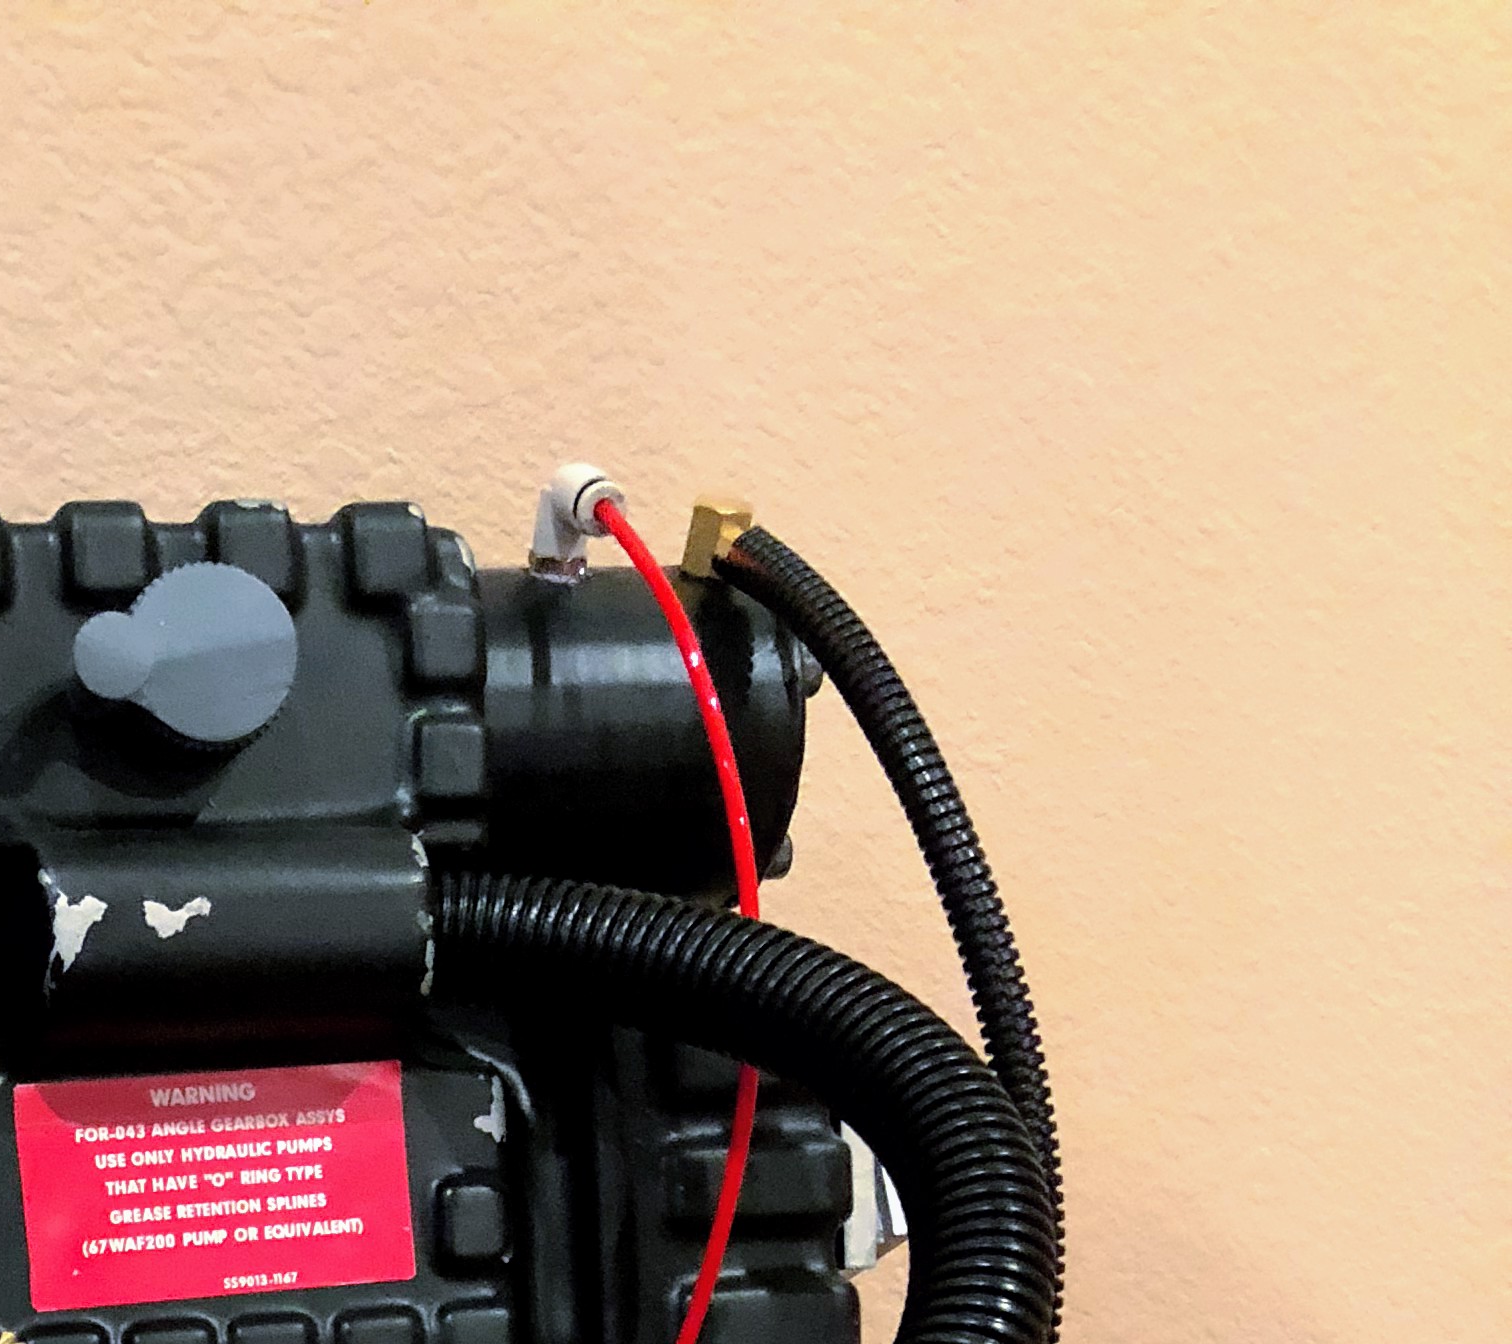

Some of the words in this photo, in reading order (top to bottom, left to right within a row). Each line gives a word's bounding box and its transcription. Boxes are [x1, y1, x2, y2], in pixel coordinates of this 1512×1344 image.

[150, 1082, 256, 1107] WARNING
[75, 1125, 146, 1143] FOR-043
[151, 1119, 206, 1137] ANGLE
[210, 1113, 290, 1133] GEARBOX
[295, 1108, 345, 1126] ASSYS
[95, 1153, 127, 1169] USE
[130, 1149, 174, 1167] ONLY
[180, 1141, 273, 1163] HYDRAULIC
[276, 1136, 333, 1155] PUMPS
[105, 1178, 147, 1196] THAT
[152, 1174, 198, 1192] HAVE
[203, 1172, 234, 1188] "O"
[240, 1168, 281, 1185] RING
[285, 1164, 323, 1181] TYPE
[109, 1206, 172, 1225] GREASE
[176, 1198, 262, 1219] RETENTION
[267, 1193, 327, 1212] SPLINES
[82, 1233, 176, 1258] (67WAF200
[182, 1229, 228, 1247] PUMP
[234, 1226, 259, 1242] OR
[264, 1217, 364, 1241] EQUIVALENT)
